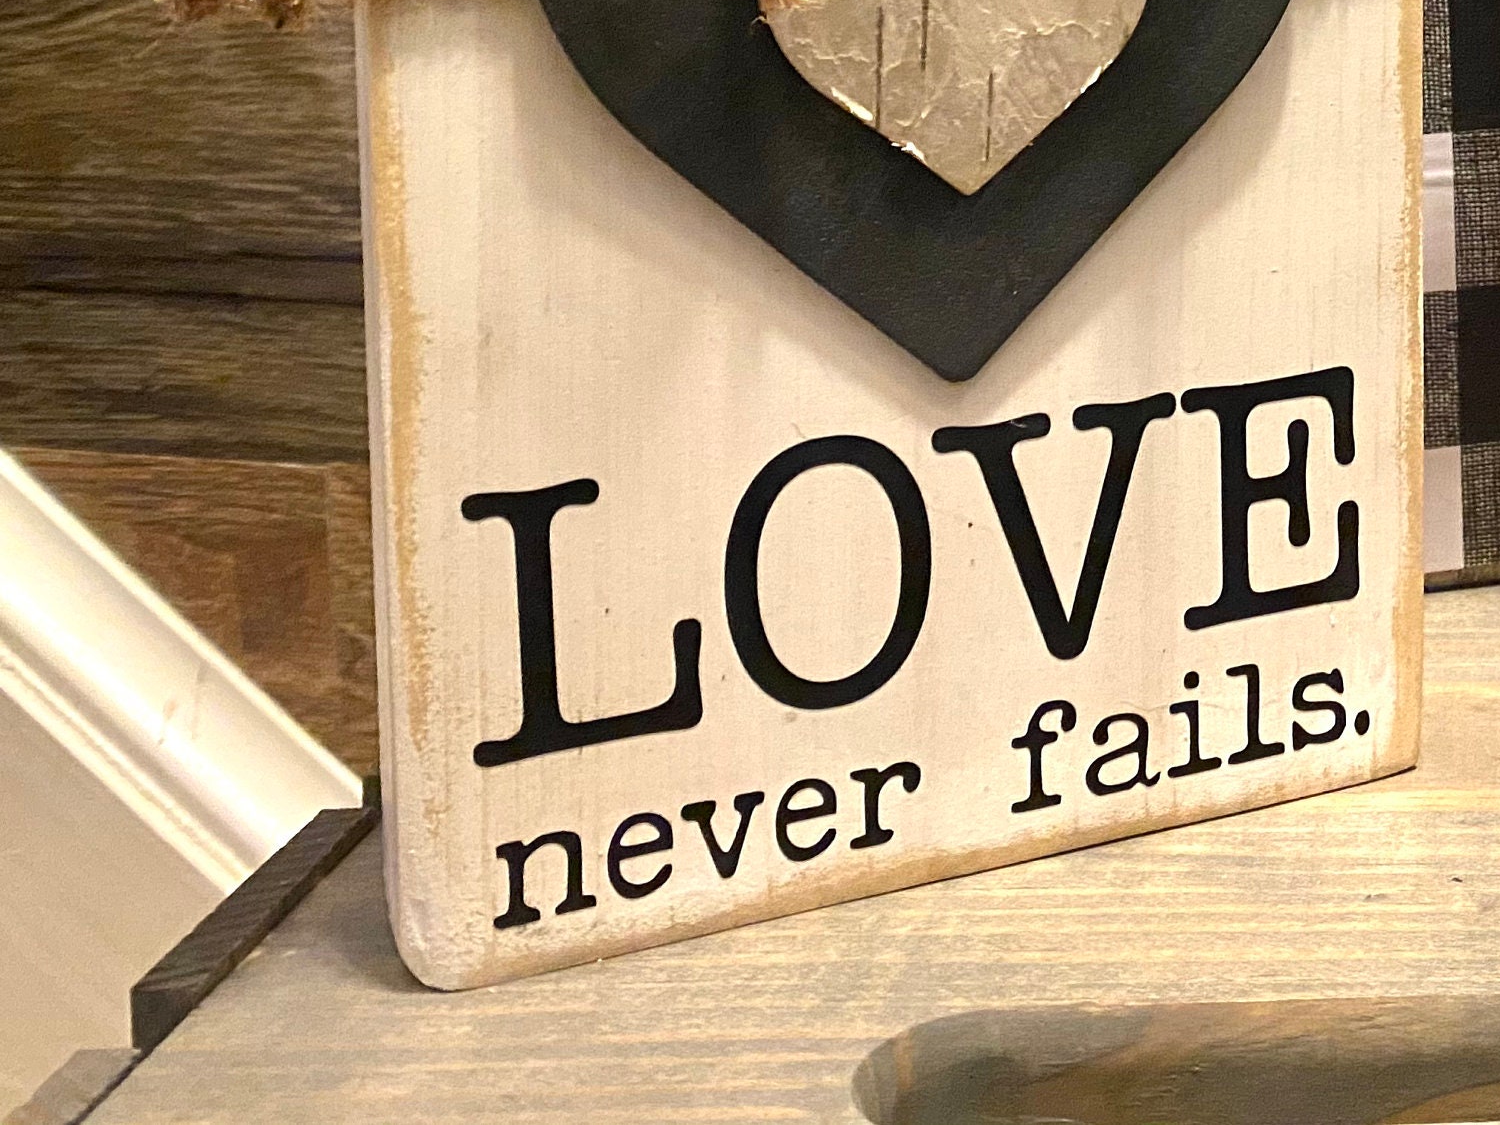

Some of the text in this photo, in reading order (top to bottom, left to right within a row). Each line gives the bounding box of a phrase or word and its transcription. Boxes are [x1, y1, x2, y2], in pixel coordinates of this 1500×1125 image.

[461, 366, 1359, 767] LOVE
[493, 663, 1371, 929] never fails.
